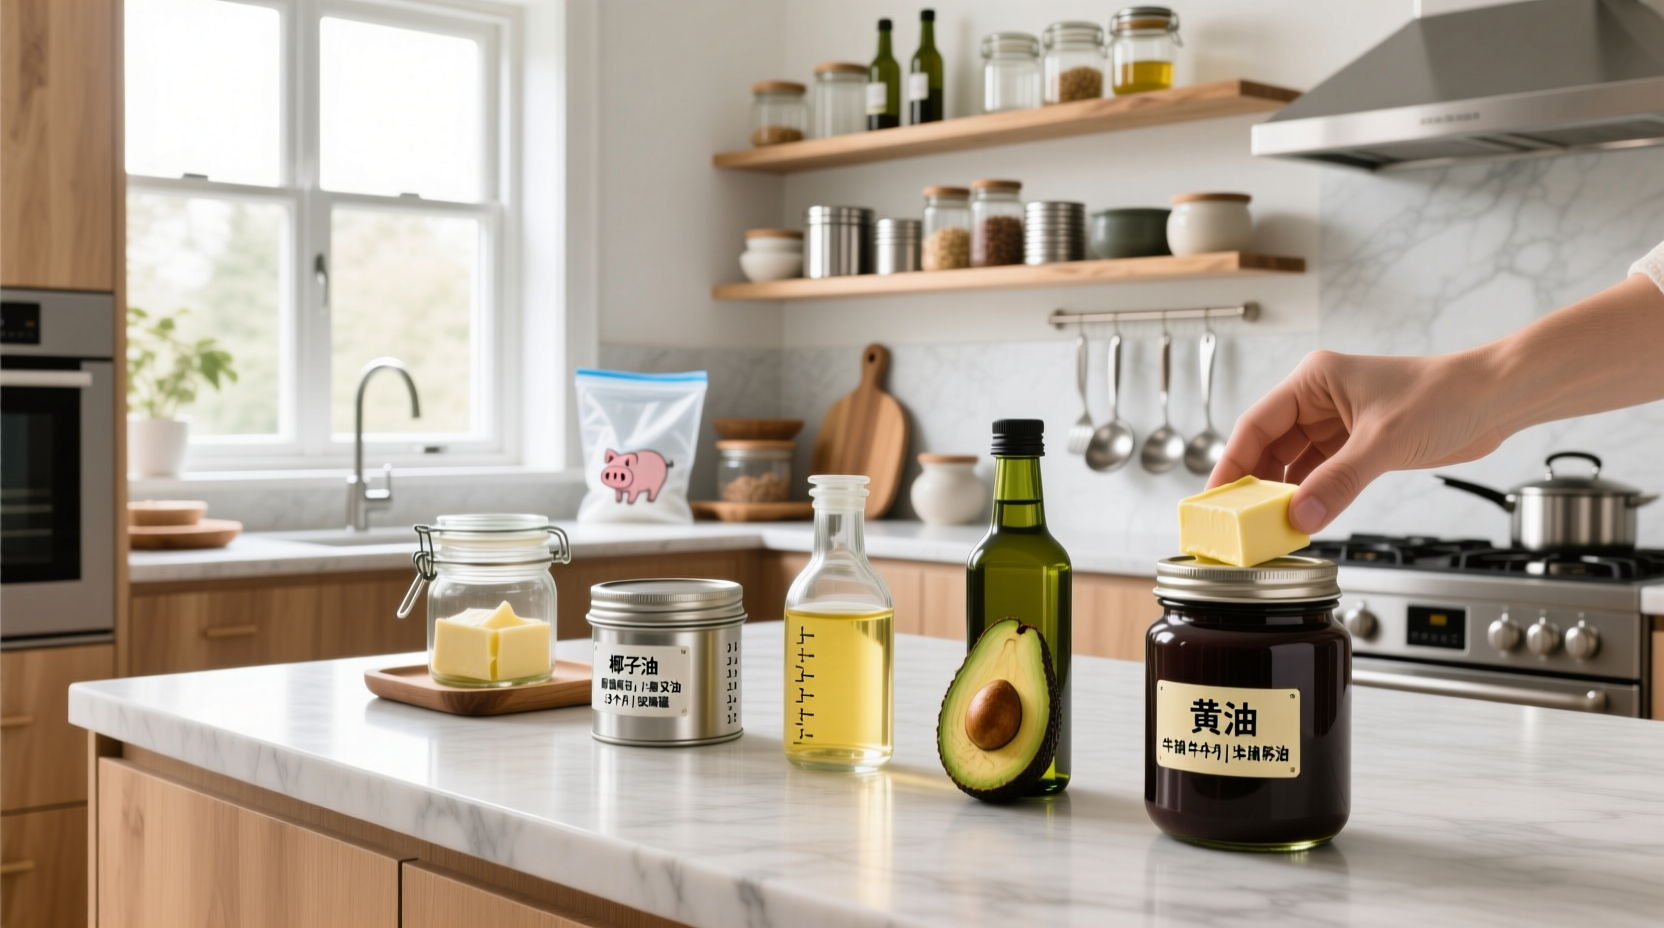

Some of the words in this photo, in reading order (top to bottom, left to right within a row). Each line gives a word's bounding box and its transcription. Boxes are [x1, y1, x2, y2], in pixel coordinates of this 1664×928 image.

[609, 654, 658, 676] 椰子油
[1190, 698, 1257, 737] 黄油
